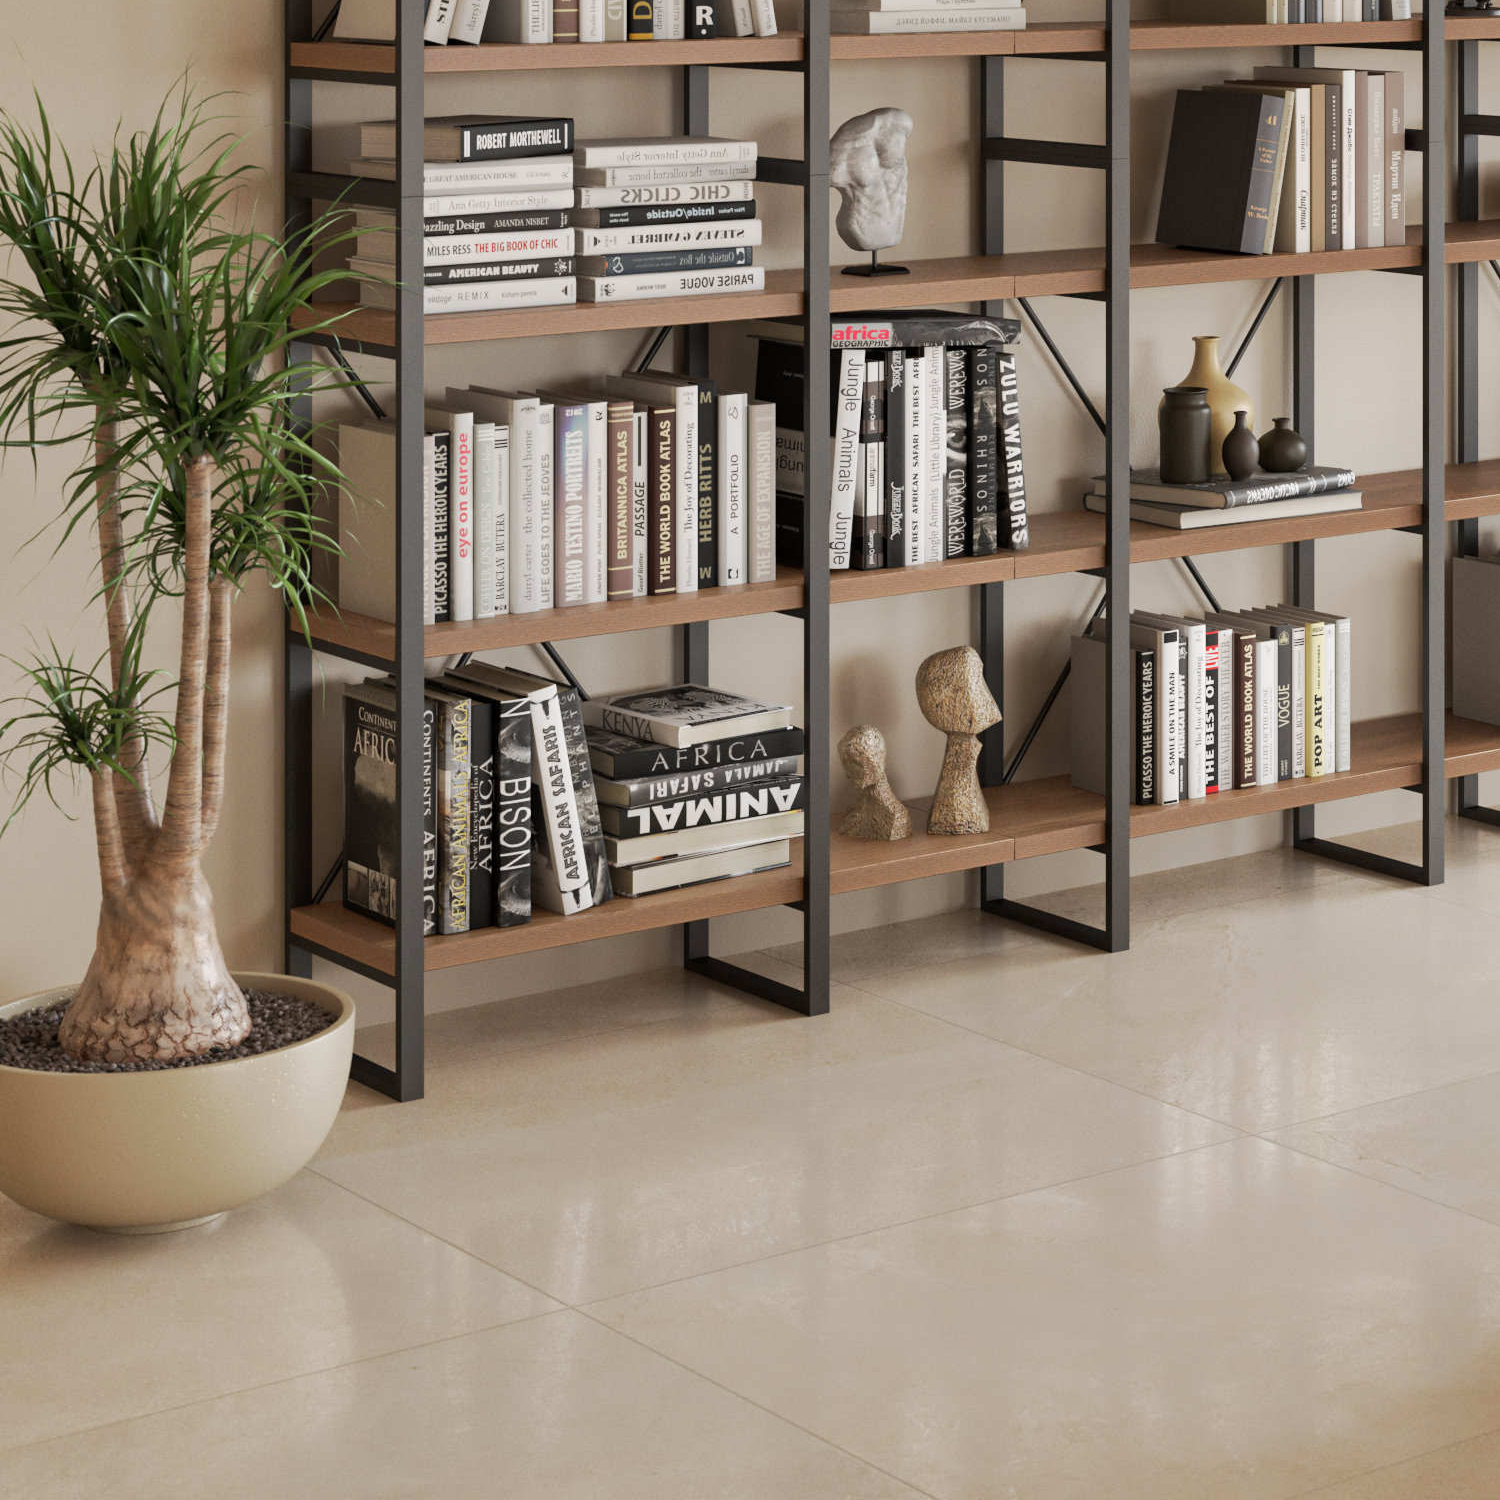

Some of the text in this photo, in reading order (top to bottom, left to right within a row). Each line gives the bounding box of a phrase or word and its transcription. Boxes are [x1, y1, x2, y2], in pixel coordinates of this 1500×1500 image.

[476, 128, 562, 151] ROBERT MORTHEWELL
[1265, 115, 1277, 126] 41
[1390, 150, 1401, 220] Мартин Иден
[456, 219, 486, 233] Design
[494, 218, 524, 228] AMANDA
[525, 216, 550, 226] NISBET
[426, 238, 559, 257] MILES RESS THE BIG BOOK OF CHIC
[448, 263, 540, 279] AMERICAN BEAUTY
[457, 291, 490, 301] REMIX
[832, 325, 890, 341] africa
[832, 339, 890, 348] GEOGRAPHIC
[829, 358, 863, 566] Jungle Animals Jungle
[999, 357, 1028, 544] ZULU WARRIORS
[459, 433, 471, 558] eye on europe
[699, 443, 713, 543] HERB RITTS
[976, 435, 988, 512] RHINOS
[541, 500, 550, 522] THE
[634, 481, 645, 537] PASSAGE
[659, 420, 671, 583] THE WORLD BOOK ATLAS
[948, 468, 966, 556] WEREWORLD
[541, 525, 550, 541] TO
[541, 548, 550, 576] GOES
[541, 579, 550, 603] LIFE
[1205, 675, 1215, 699] OF
[1278, 683, 1290, 728] VOGUE
[602, 710, 655, 741] KENYA
[1205, 701, 1215, 744] BEST
[1314, 694, 1323, 767] POP ART
[353, 729, 397, 766] AFRIC
[567, 692, 599, 835] ELEPHANTS
[651, 739, 768, 772] AFRICA
[1205, 747, 1215, 785] THE
[543, 724, 580, 880] AFRICAN SAFARIS
[649, 760, 784, 800] JAMALA SAFARI
[423, 709, 436, 932] CONTINENTS AFRICA
[452, 700, 469, 929] AFRICAN ANIMALS AFRICA
[470, 763, 480, 870] New Encyclopedia of
[479, 755, 493, 874] AFRICA
[499, 776, 532, 871] BISON
[627, 783, 801, 835] ANIMAL
